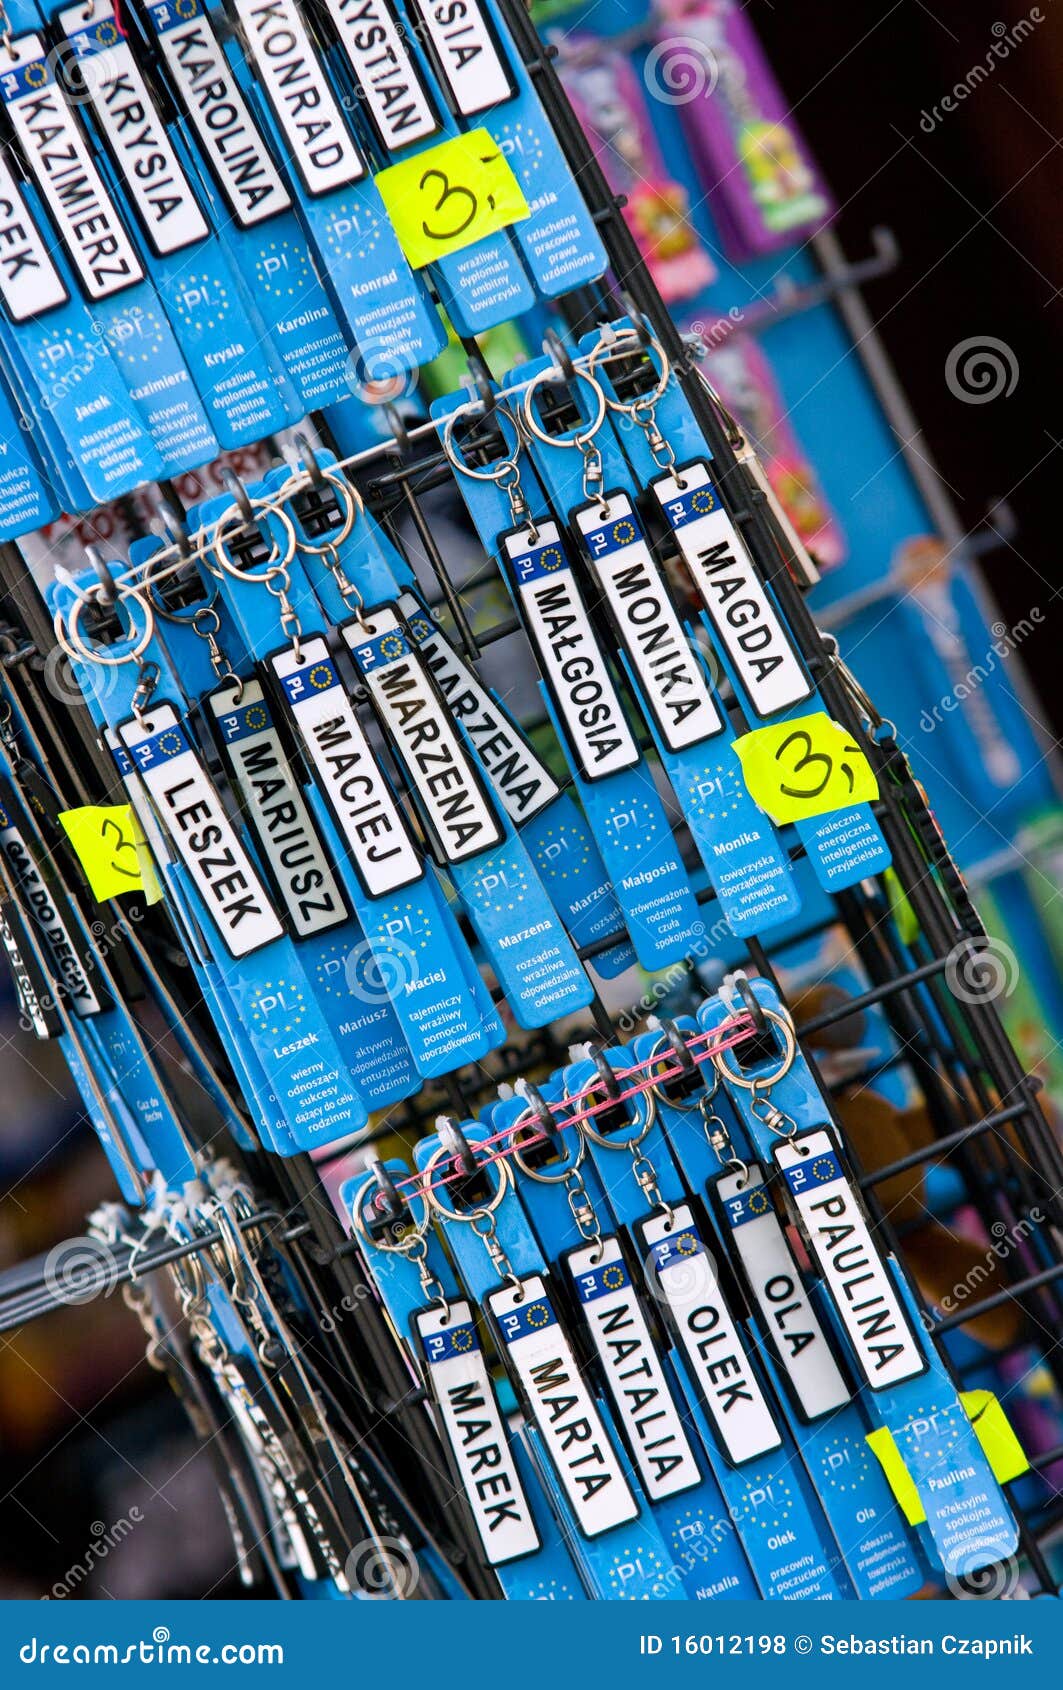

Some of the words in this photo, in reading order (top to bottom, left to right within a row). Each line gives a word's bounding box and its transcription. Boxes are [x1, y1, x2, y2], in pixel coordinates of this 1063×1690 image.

[153, 6, 172, 30] PL
[430, 0, 483, 70] SIA
[0, 73, 20, 98] PL
[251, 0, 344, 170] KONRAD
[171, 28, 275, 211] KAROLINA
[100, 72, 184, 222] KRYSIA
[19, 93, 131, 287] KAZIMIERZ
[528, 191, 558, 213] asia
[526, 214, 577, 243] szlachetna
[534, 228, 581, 256] pracowita
[541, 251, 596, 282] uzdolniona
[548, 244, 578, 265] prawa
[351, 269, 398, 297] Konrad
[459, 259, 510, 287] dyplomata
[470, 273, 509, 298] ambitny
[469, 284, 521, 313] towarzyski
[276, 306, 329, 335] Karolina
[203, 342, 246, 369] Krysia
[300, 360, 347, 387] pracowita
[75, 395, 112, 422] Jacek
[225, 395, 266, 419] ambitna
[668, 502, 687, 525] PL
[590, 532, 608, 555] PL
[517, 557, 534, 580] PL
[696, 541, 784, 683] MAGDA
[357, 646, 377, 669] PL
[611, 563, 701, 726] MONIKA
[534, 583, 623, 763] MAŁGOSIA
[286, 676, 304, 700] PL
[223, 716, 241, 739] PL
[423, 643, 543, 812] MARZENA
[135, 744, 155, 768] PL
[376, 663, 483, 849] MARZENA
[312, 714, 403, 864] MACIEJ
[240, 741, 335, 922] MARIUSZ
[815, 811, 861, 838] waleczna
[817, 822, 871, 852] energiczna
[163, 777, 262, 929] LESZEK
[713, 830, 761, 857] Monika
[820, 833, 879, 865] inteligentna
[622, 860, 678, 890] Małgosia
[719, 854, 776, 884] towarzyska
[826, 845, 884, 878] przyjacielska
[29, 888, 56, 923] DO
[568, 880, 613, 915] Marzen
[629, 885, 690, 917] zrównoważona
[738, 893, 788, 921] sympatyczna
[646, 903, 682, 924] rodzinna
[657, 919, 680, 934] czuła
[498, 919, 553, 950] Marzena
[655, 929, 692, 950] spokojna
[515, 946, 561, 972] rozsądna
[403, 968, 447, 994] Maciej
[520, 967, 581, 1000] odpowiedzialna
[338, 1008, 388, 1036] Mariusz
[408, 995, 462, 1022] tajemniczy
[418, 1009, 462, 1033] wrażliwy
[273, 1032, 319, 1059] Leszek
[354, 1037, 393, 1059] aktywny
[419, 1031, 481, 1062] uporządkowany
[423, 1022, 468, 1047] pomocny
[290, 1061, 325, 1081] wierny
[350, 1045, 409, 1076] odpowiedzialny
[360, 1059, 409, 1086] entuzjasta
[287, 1069, 340, 1098] odnoszący
[299, 1085, 339, 1108] sukcesy
[368, 1072, 411, 1097] rodzinny
[295, 1102, 323, 1124] dążący
[324, 1099, 335, 1112] do
[336, 1092, 353, 1106] celu
[308, 1108, 352, 1134] rodzinny
[789, 1168, 807, 1190] PL
[729, 1200, 745, 1222] PL
[656, 1243, 673, 1265] PL
[581, 1276, 599, 1299] PL
[810, 1194, 905, 1370] PAULINA
[503, 1315, 521, 1338] PL
[764, 1275, 816, 1358] OLA
[429, 1339, 446, 1360] PL
[687, 1305, 753, 1413] OLEK
[598, 1304, 684, 1482] NATALIA
[529, 1358, 612, 1502] MARTA
[447, 1381, 521, 1532] MAREK
[928, 1465, 977, 1493] Paulina
[856, 1507, 876, 1523] Ola
[945, 1506, 992, 1532] spokojna
[767, 1530, 796, 1550] Olek
[770, 1554, 815, 1581] pracowity
[776, 1564, 826, 1593] poczuciem
[696, 1575, 740, 1600] Natalia
